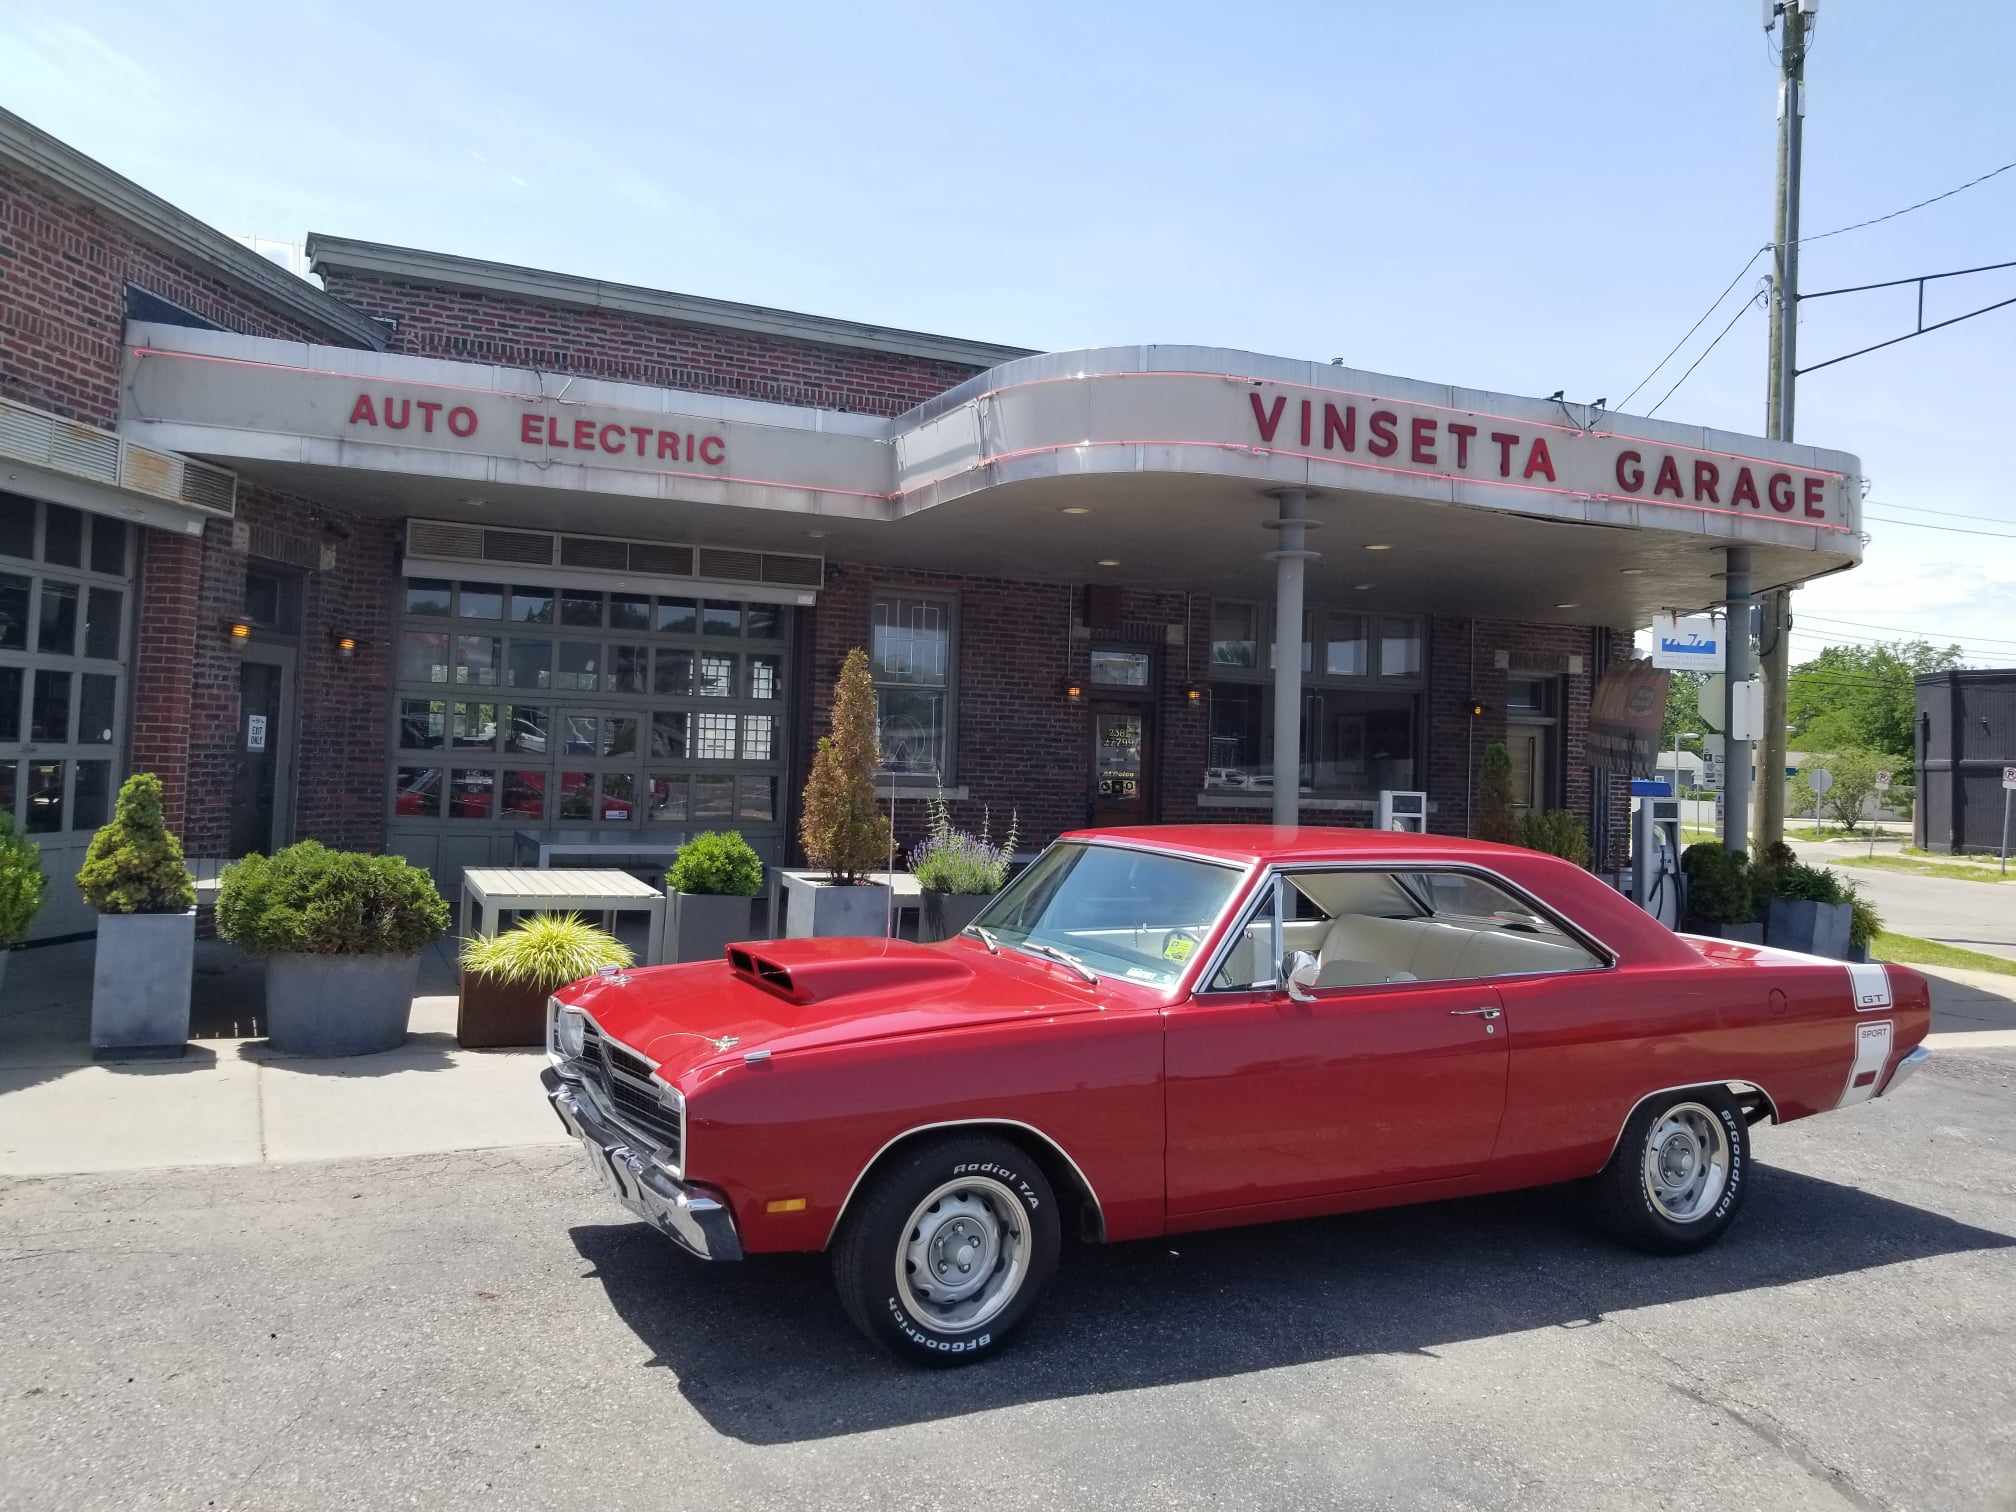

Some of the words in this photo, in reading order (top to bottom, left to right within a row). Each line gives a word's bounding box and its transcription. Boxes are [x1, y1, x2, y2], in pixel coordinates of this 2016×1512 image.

[350, 394, 478, 438] AUTO
[521, 413, 726, 465] ELECTRIC
[1249, 392, 1556, 482] VINSETTA
[1615, 450, 1825, 519] GARAGE
[1862, 994, 1884, 1004] GT
[1861, 1028, 1888, 1039] SPORT
[953, 1162, 1017, 1182] Radial
[1018, 1180, 1040, 1209] T/A
[1715, 1109, 1741, 1218] BFGoodrich
[888, 1296, 991, 1352] BFGoodrich
